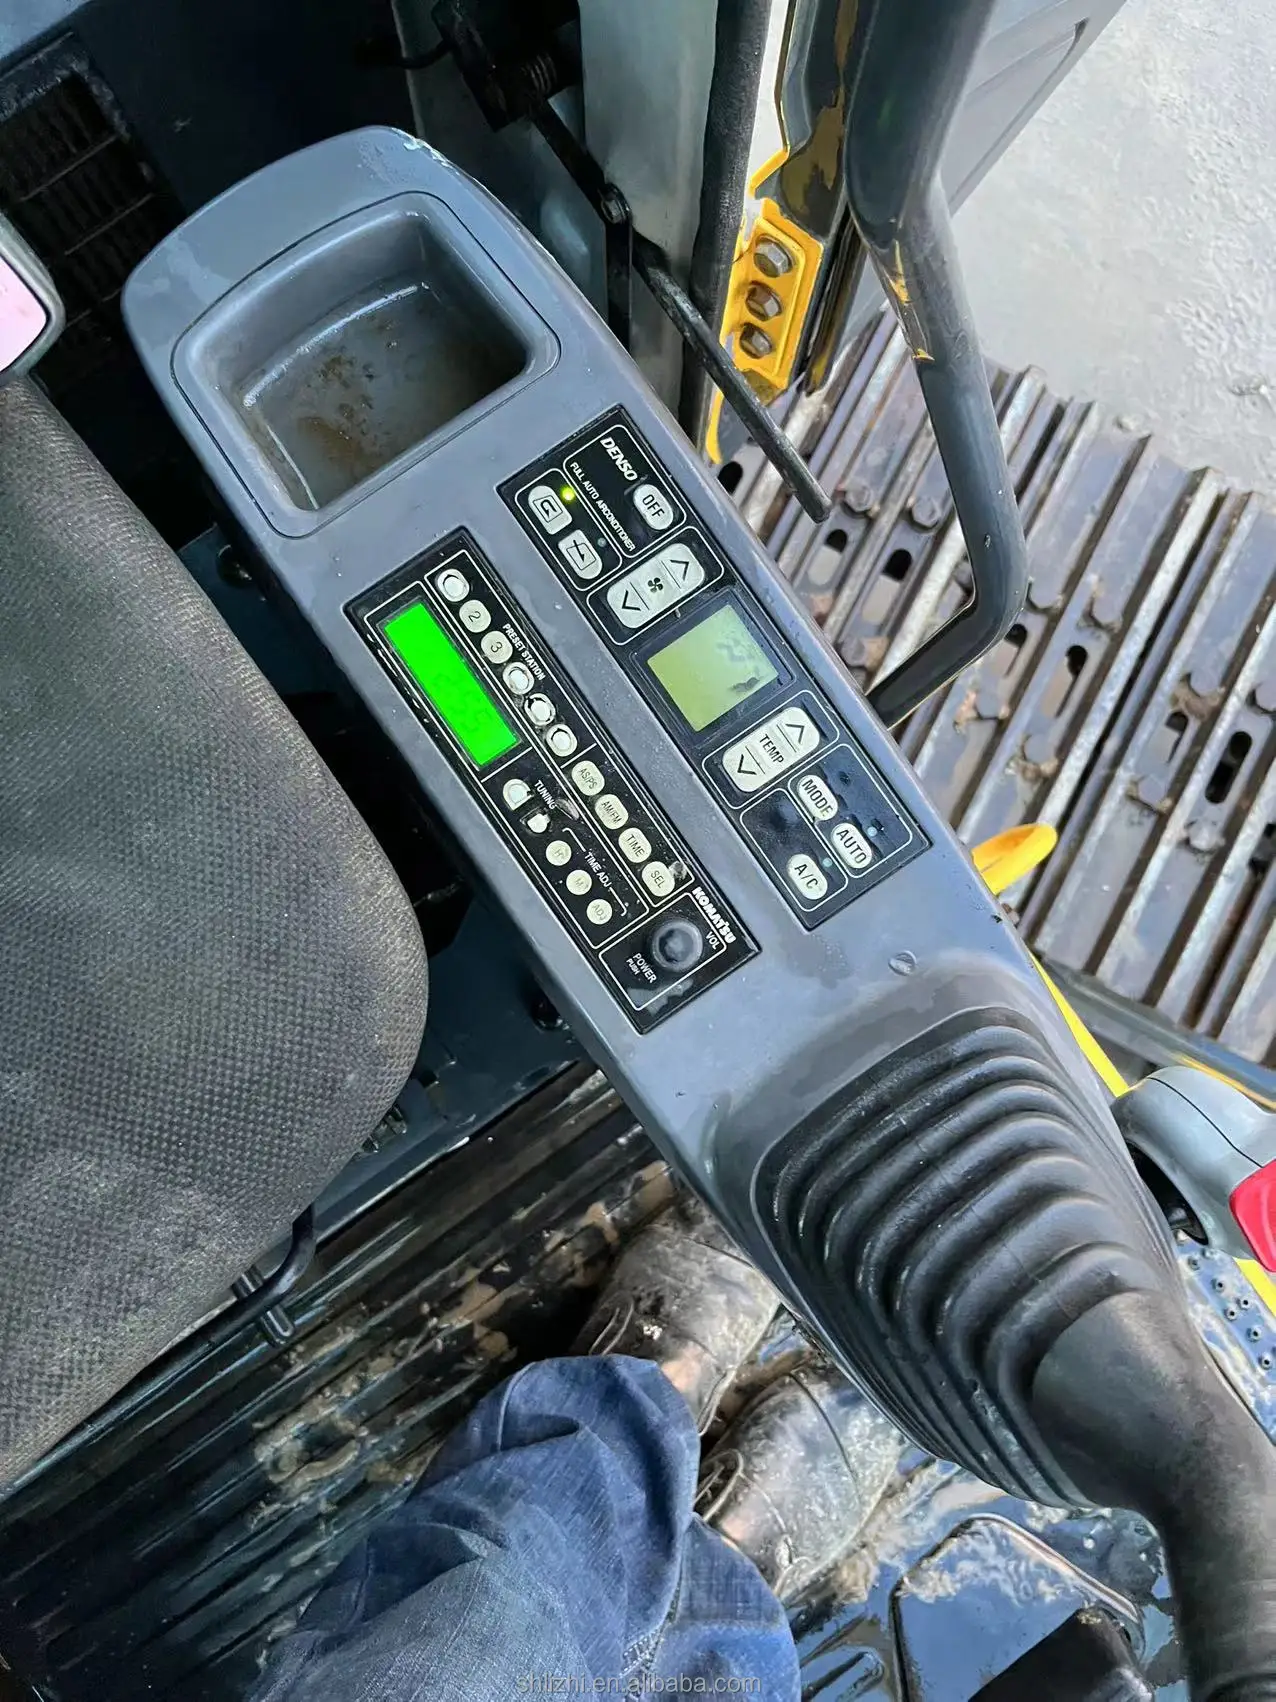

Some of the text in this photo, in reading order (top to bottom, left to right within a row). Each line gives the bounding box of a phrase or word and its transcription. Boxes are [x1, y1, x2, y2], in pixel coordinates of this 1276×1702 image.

[600, 437, 638, 481] DENSO
[570, 462, 636, 552] FULL AUTO AIRCONDITIONER
[642, 494, 665, 517] OFF
[468, 610, 481, 623] 2
[490, 641, 503, 653] 3
[502, 623, 546, 681] PRESET STATION
[759, 733, 785, 764] TEMP
[579, 768, 598, 790] AS/PS
[534, 779, 557, 810] TUNING
[801, 778, 833, 818] MODE
[601, 801, 622, 824] AM/FM
[625, 834, 645, 857] TIME
[836, 829, 867, 864] AUTO
[584, 851, 612, 888] TIME ADJ
[651, 870, 665, 889] SEL
[794, 863, 819, 890] A/C
[691, 886, 737, 944] KOMATSU
[705, 931, 720, 950] VOL
[626, 958, 640, 975] PUSH
[632, 952, 657, 984] POWER
